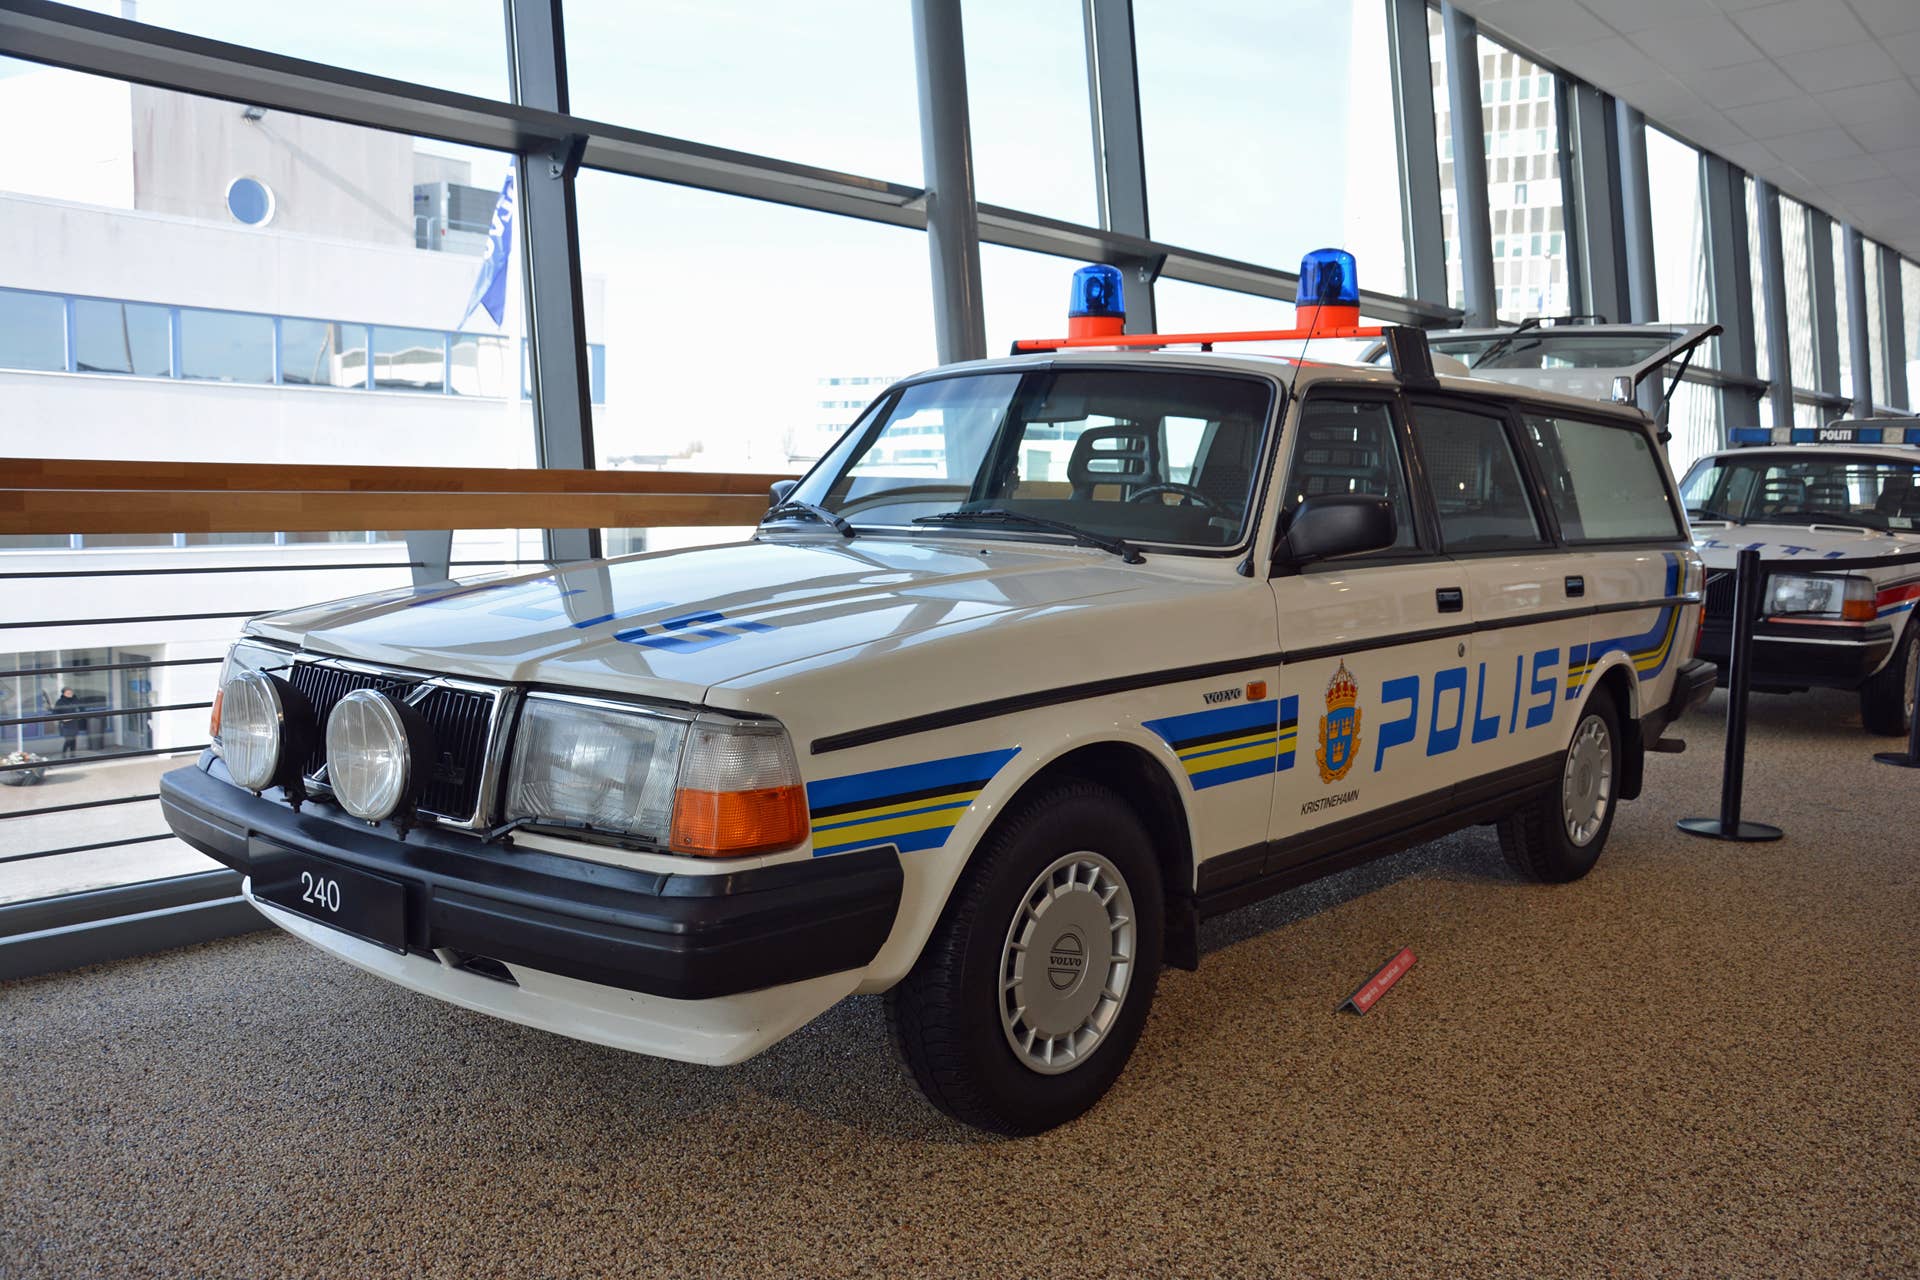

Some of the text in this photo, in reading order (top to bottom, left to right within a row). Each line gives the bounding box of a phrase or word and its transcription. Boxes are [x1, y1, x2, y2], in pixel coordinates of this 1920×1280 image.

[1819, 429, 1853, 441] POLITI
[1203, 687, 1243, 705] VOLVO
[1373, 647, 1560, 773] POLIS
[1300, 789, 1360, 817] KRISTINEHAMN
[301, 871, 341, 913] 240
[1049, 955, 1082, 967] VOLVO
